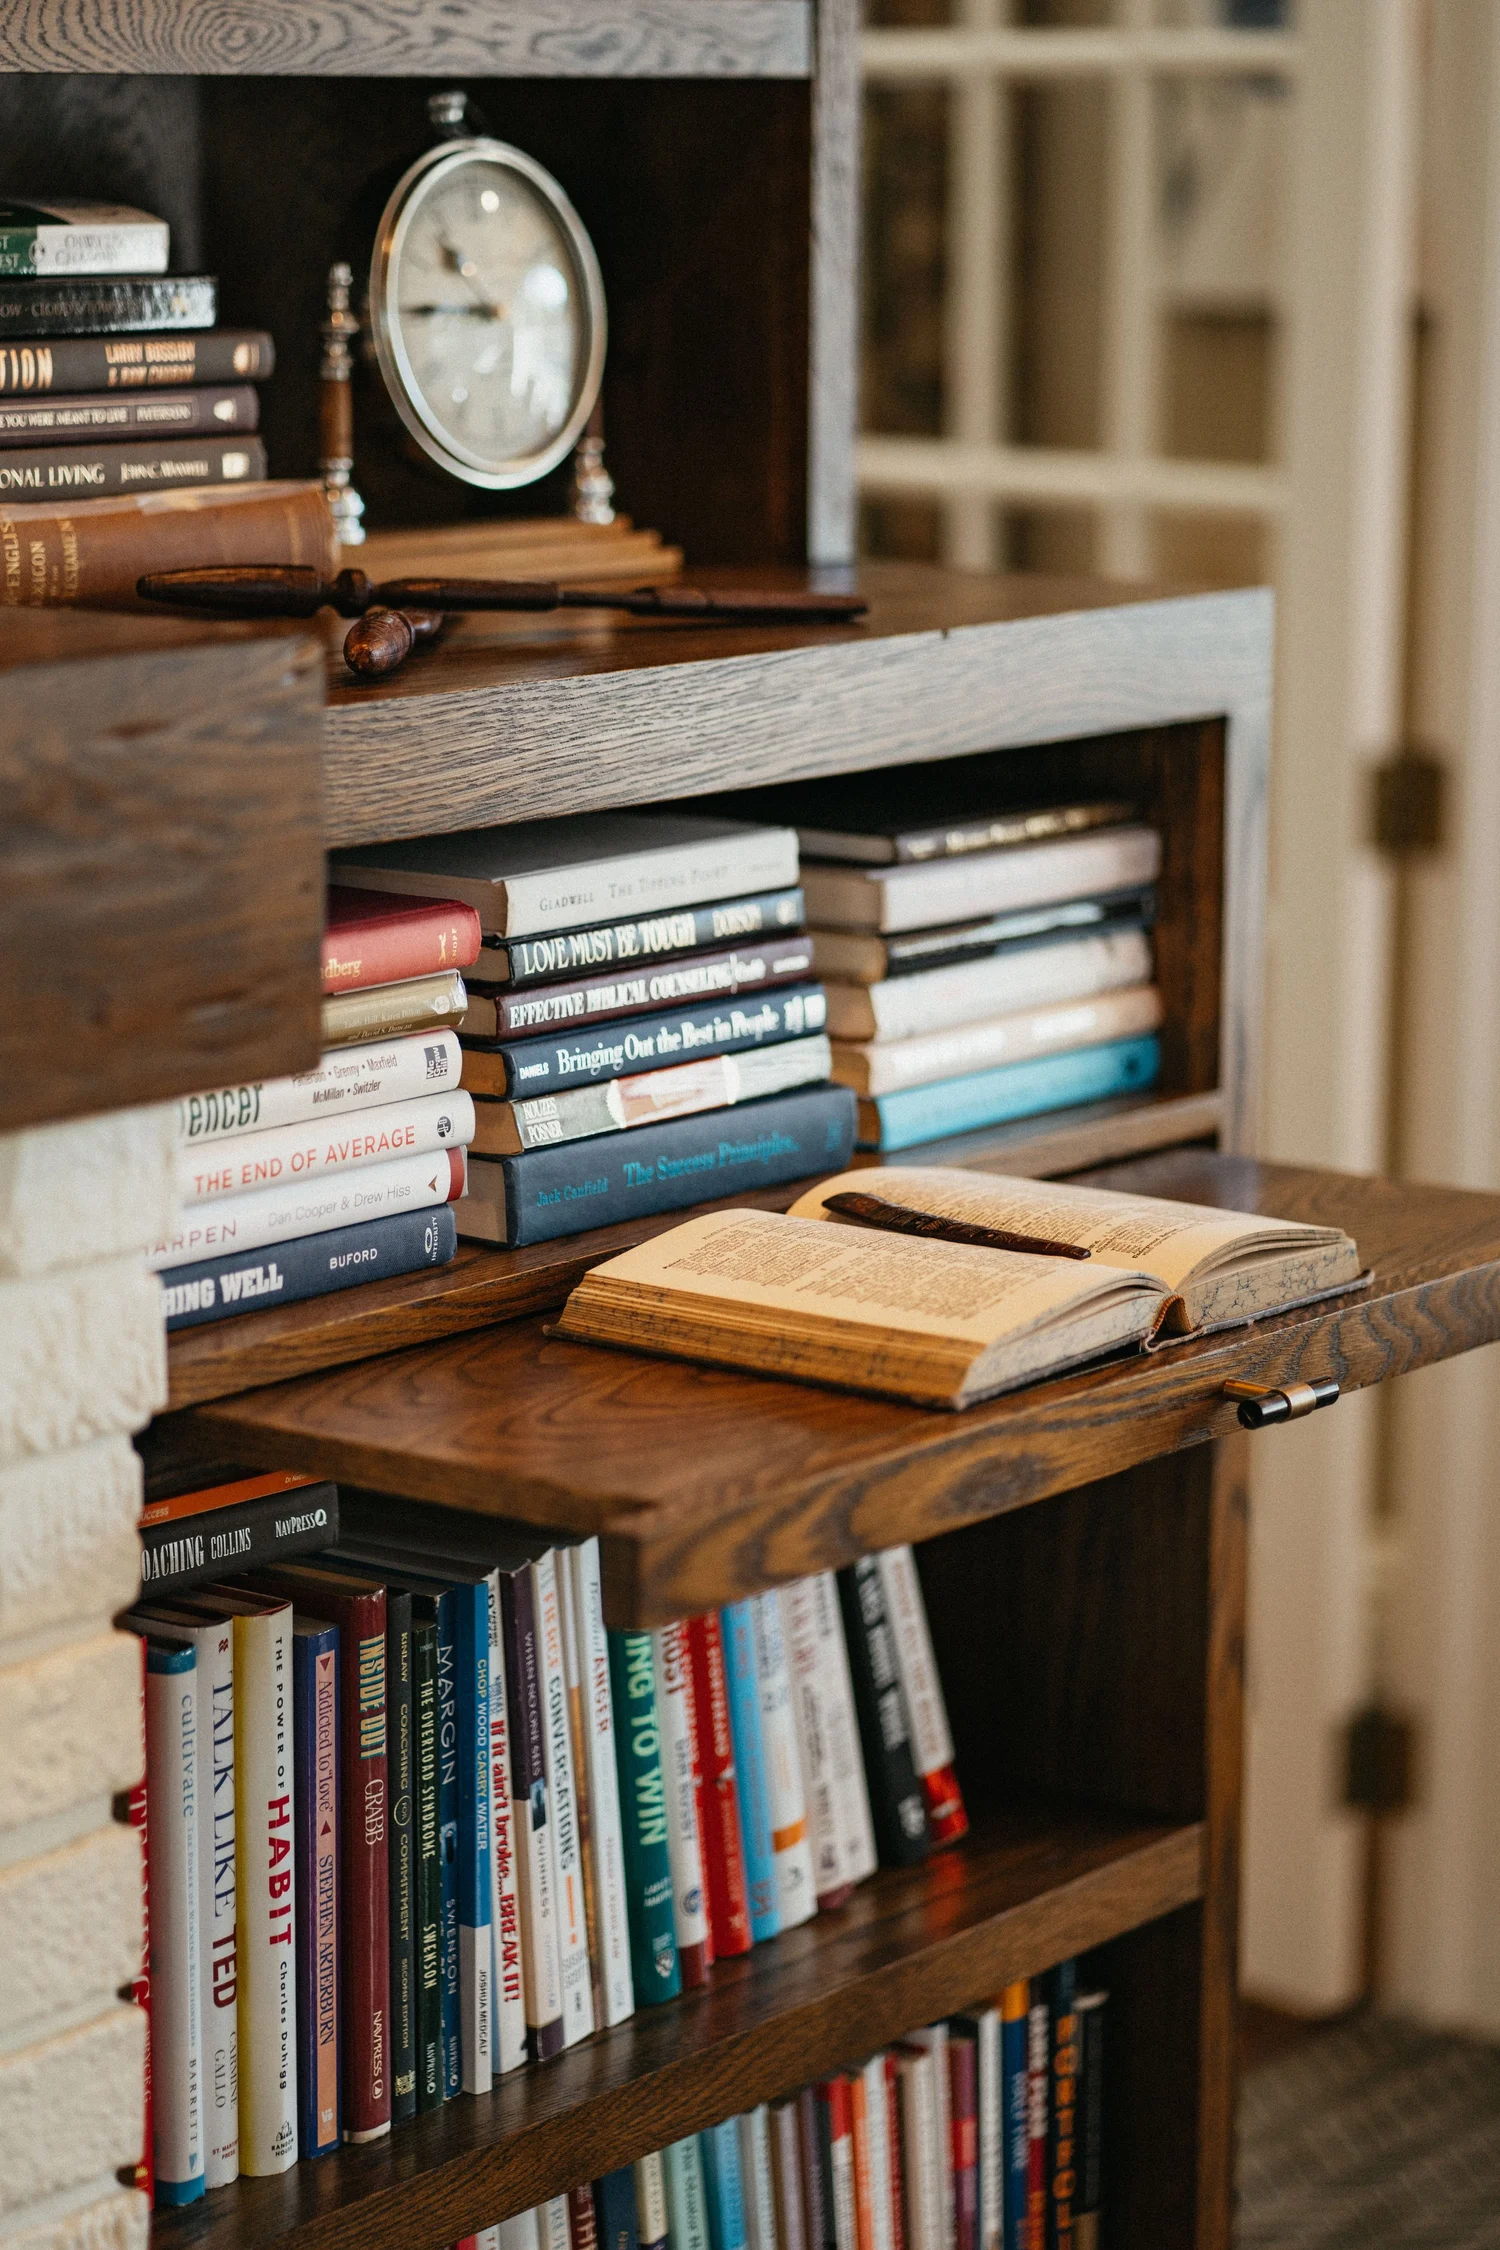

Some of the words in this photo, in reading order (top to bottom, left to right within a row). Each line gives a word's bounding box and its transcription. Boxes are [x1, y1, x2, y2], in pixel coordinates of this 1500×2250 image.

[6, 413, 28, 428] YOU
[28, 411, 55, 426] WERE
[56, 408, 92, 425] MEANT
[0, 467, 45, 489] ONAL
[49, 463, 105, 486] LIVING
[540, 892, 595, 912] GLADWELL
[524, 937, 574, 976] LOVE
[572, 927, 614, 964] MUST
[617, 923, 641, 957] BE
[639, 912, 697, 954] TOUGH
[381, 1013, 401, 1025] Karen
[509, 991, 585, 1030] EFFECTIVE
[585, 979, 650, 1014] BIBLICAL
[649, 963, 732, 1001] COUNSELING
[361, 1028, 380, 1040] David
[388, 1023, 413, 1035] Duncan
[519, 1062, 550, 1081] DANIELS
[556, 1042, 624, 1077] Bringing
[624, 1031, 654, 1061] Out
[657, 1026, 682, 1055] the
[681, 1018, 715, 1048] Best
[713, 1016, 731, 1040] in
[730, 1003, 780, 1041] People
[333, 1064, 361, 1082] Grenny
[367, 1053, 398, 1073] Maxfield
[427, 1059, 435, 1078] Mc
[433, 1047, 441, 1077] Graw
[440, 1058, 448, 1076] Hill
[312, 1087, 345, 1105] McMillan
[352, 1078, 381, 1096] Switzler
[522, 1095, 557, 1121] KOUZES
[528, 1119, 563, 1143] POSNER
[194, 1169, 232, 1196] THE
[241, 1156, 283, 1185] END
[291, 1147, 318, 1173] OF
[325, 1125, 416, 1166] AVERAGE
[536, 1188, 562, 1208] Jack
[563, 1177, 609, 1202] Canfield
[622, 1162, 656, 1190] The
[656, 1149, 717, 1182] Success
[268, 1211, 292, 1228] Dan
[294, 1203, 338, 1227] Cooper
[341, 1198, 351, 1211] &
[354, 1191, 384, 1209] Drew
[387, 1184, 412, 1200] Hiss
[430, 1215, 438, 1262] INTEGRITY
[219, 1262, 284, 1304] WELL
[329, 1248, 378, 1271] BUFORD
[141, 1534, 205, 1582] OACHING
[210, 1527, 252, 1560] COLLINS
[524, 1631, 536, 1680] WHEN
[543, 1592, 561, 1669] FIERCE
[357, 1632, 386, 1713] INSIDE
[421, 1678, 433, 1707] THE
[477, 1658, 487, 1700] CHOP
[527, 1682, 538, 1708] NO
[592, 1655, 612, 1734] ANGER
[624, 1633, 654, 1709] ING
[212, 1668, 235, 1799] TALK
[276, 1683, 285, 1755] POWER
[318, 1680, 332, 1754] Addicted
[359, 1713, 387, 1760] OUT
[437, 1645, 456, 1787] MARGIN
[477, 1701, 488, 1747] WOOD
[491, 1719, 506, 1737] If
[528, 1710, 539, 1744] ONE
[629, 1713, 661, 1758] TO
[319, 1756, 332, 1772] to
[400, 1703, 408, 1791] COACHING
[421, 1710, 435, 1782] OVERLOAD
[491, 1739, 504, 1758] it
[532, 1745, 543, 1777] SEES
[549, 1674, 577, 1871] CONVERSATIONS
[277, 1765, 285, 1790] OF
[477, 1750, 488, 1799] CARRY
[363, 1778, 385, 1847] CRABB
[421, 1786, 436, 1860] SYNDROME
[478, 1800, 488, 1850] WATER
[638, 1769, 671, 1848] WIN
[213, 1809, 237, 1918] LIKE
[267, 1793, 292, 1946] HABIT
[400, 1833, 409, 1942] COMMITMENT
[536, 1832, 549, 1919] GUINNESS
[181, 1694, 196, 1818] cultivate
[189, 2059, 197, 2143] BARRETT
[318, 1853, 335, 1938] STEPHEN
[212, 1922, 237, 2009] TED
[423, 1924, 436, 1990] SWENSON
[446, 1898, 457, 1996] SWENSON
[279, 1961, 288, 2025] Charles
[319, 1943, 336, 2047] ARTERBURN
[479, 1969, 487, 2009] JOSHUA
[503, 1972, 521, 2003] IT!
[373, 2010, 383, 2077] NAVPRESS
[401, 2004, 409, 2049] EDITION
[479, 2010, 487, 2057] MEDCALF
[214, 2049, 226, 2109] GALLO
[279, 2031, 288, 2091] Duhigg
